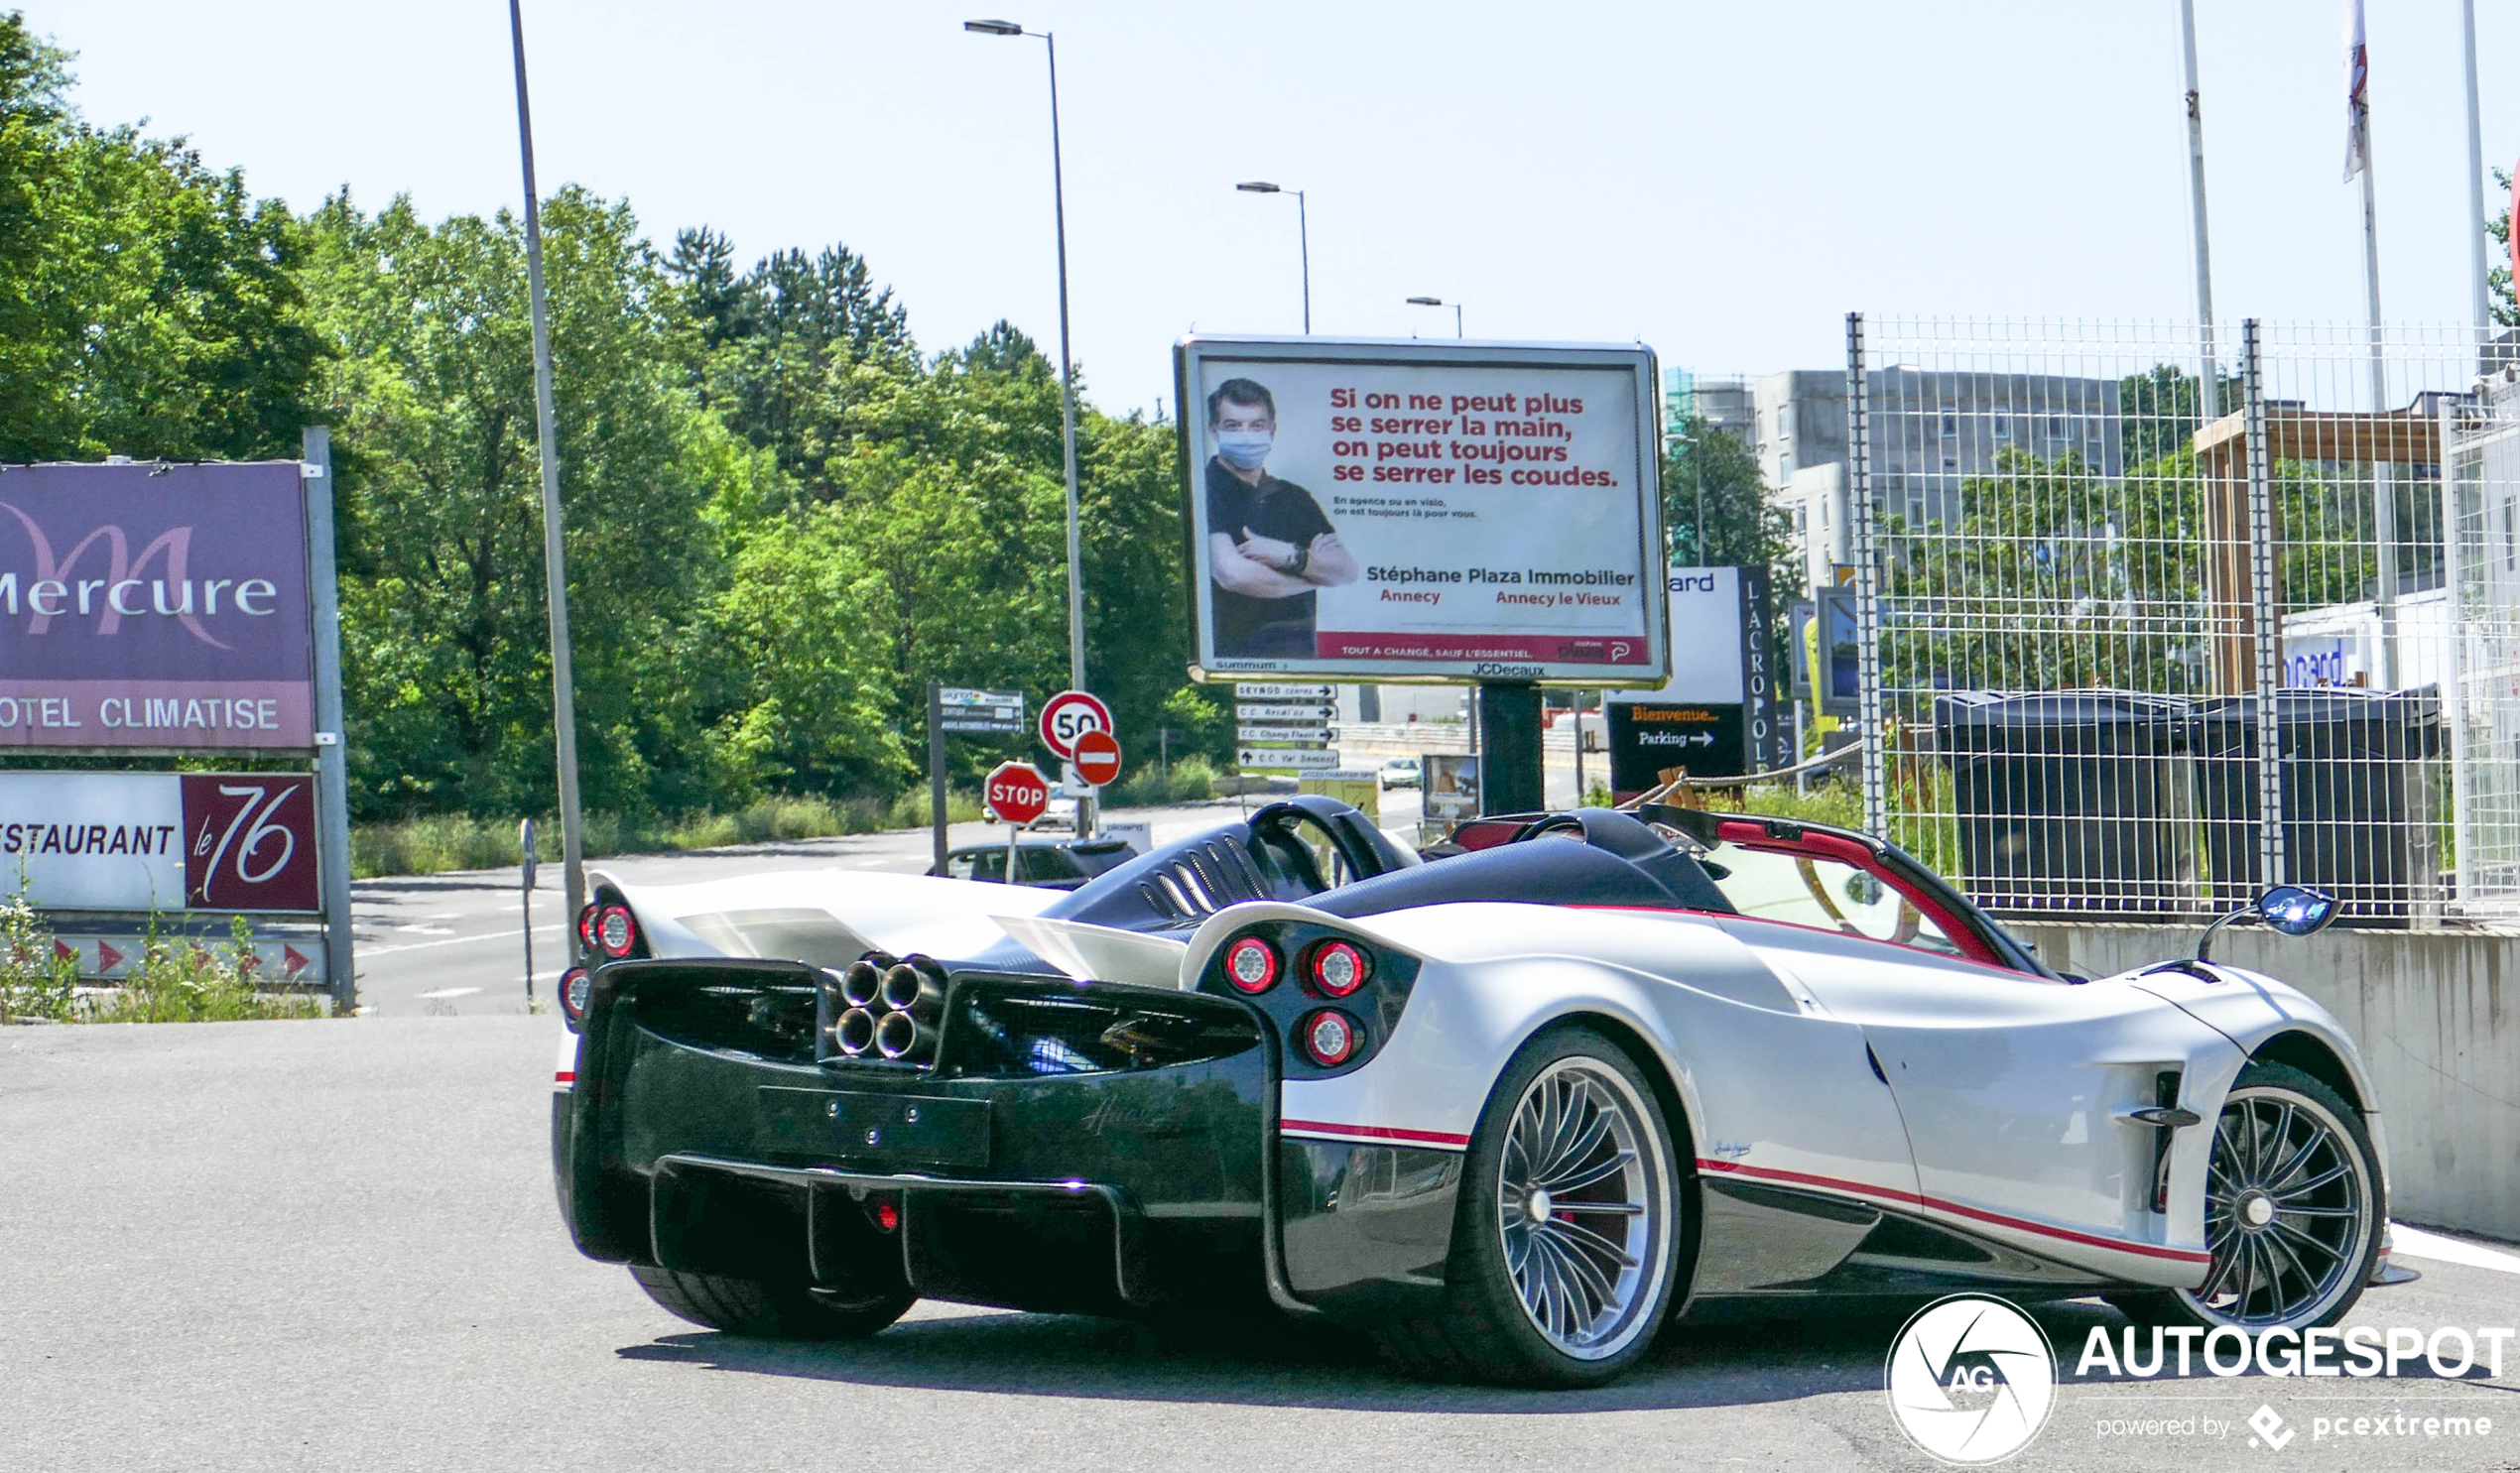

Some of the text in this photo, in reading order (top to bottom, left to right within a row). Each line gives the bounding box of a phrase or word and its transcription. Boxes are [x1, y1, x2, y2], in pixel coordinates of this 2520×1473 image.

[1330, 388, 1583, 417] Si on ne peut plus
[1330, 415, 1573, 442] se serrer la main,
[1332, 439, 1568, 464] on peut toujours
[1333, 463, 1618, 487] se serrer les coudes.
[1333, 496, 1346, 505] En
[1349, 498, 1386, 507] agence
[1405, 498, 1418, 507] en
[1421, 499, 1447, 508] visio,
[1368, 508, 1410, 519] toujours
[1425, 510, 1449, 519] pour
[1367, 566, 1635, 585] Stéphane Plaza Immobilier
[1380, 589, 1620, 607] Annecy Annecy le Vieux
[1342, 646, 1371, 655] TOUT
[1373, 647, 1381, 656] A
[1384, 646, 1434, 658] CHANGÉ,
[1436, 648, 1463, 658] SAUF
[1215, 661, 1276, 670] summum
[1472, 664, 1545, 676] JCDecaux
[2283, 638, 2341, 687] card
[0, 697, 279, 729] OTEL CLIMATISE
[1632, 705, 1719, 722] Bienvenue...
[1057, 713, 1096, 740] 50
[1260, 729, 1290, 739] Champ
[1639, 730, 1688, 748] Parking
[992, 784, 1043, 806] STOP
[0, 823, 176, 856] STAURANT
[193, 784, 300, 903] le 76
